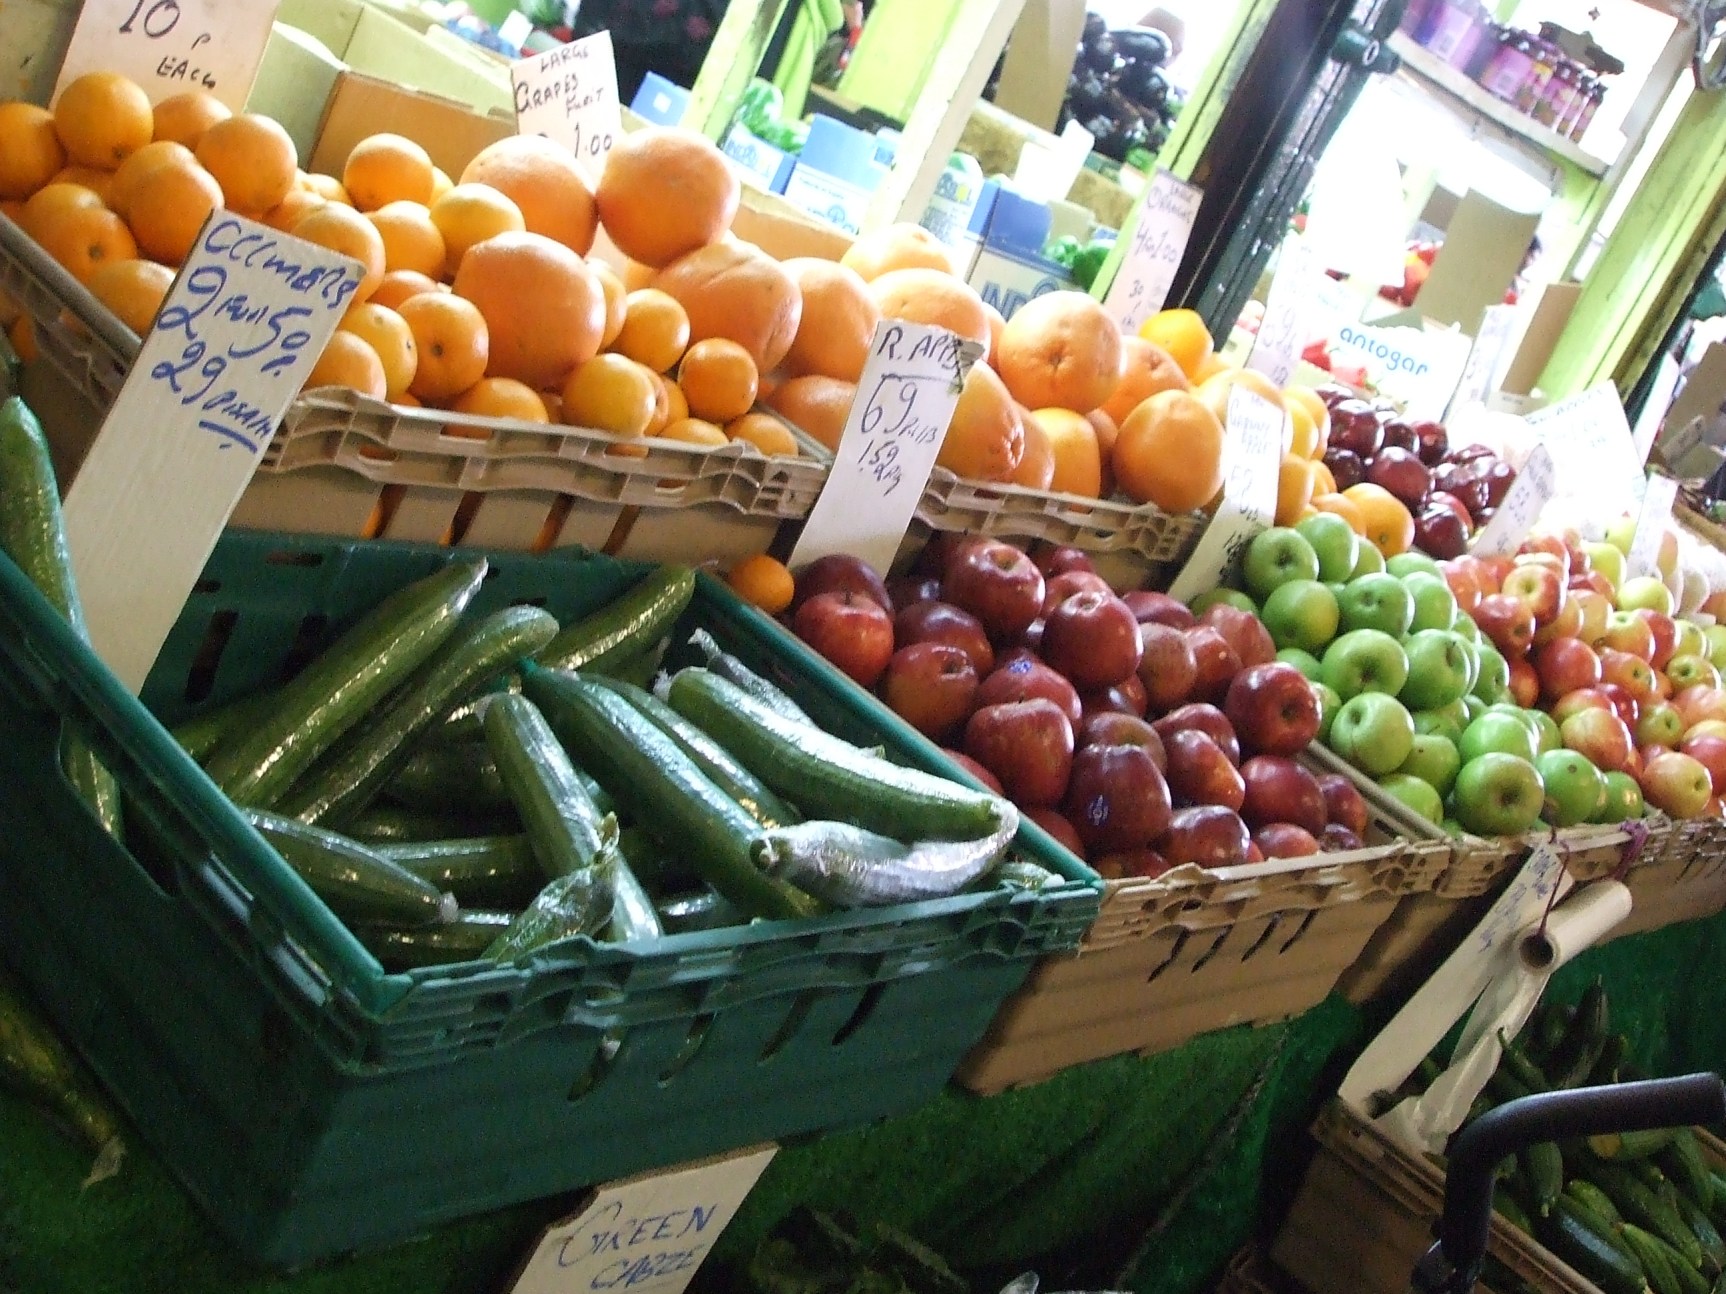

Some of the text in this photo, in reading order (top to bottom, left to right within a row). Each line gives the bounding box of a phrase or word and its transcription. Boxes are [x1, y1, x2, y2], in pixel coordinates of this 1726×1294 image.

[119, 0, 181, 39] 10
[860, 375, 918, 435] 69
[558, 1201, 718, 1268] GREEN
